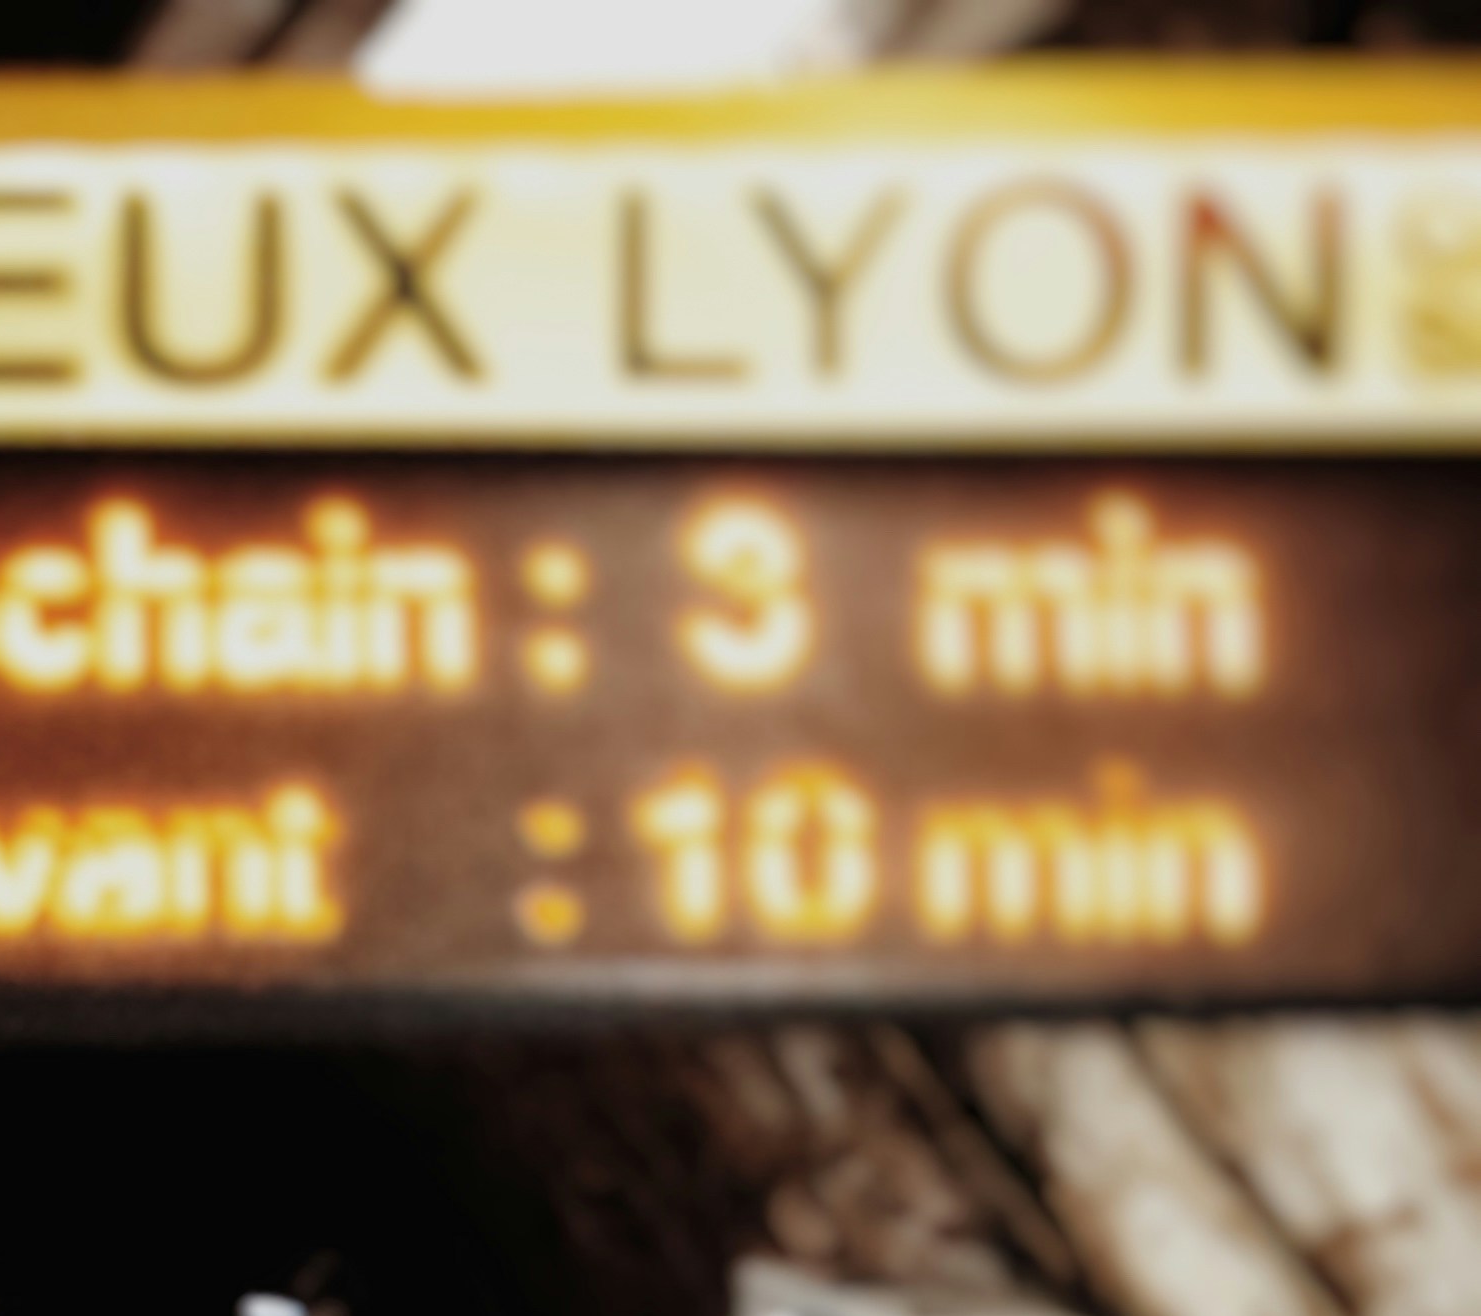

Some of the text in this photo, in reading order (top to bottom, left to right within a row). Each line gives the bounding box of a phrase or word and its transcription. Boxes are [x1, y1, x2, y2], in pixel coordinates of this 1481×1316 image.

[612, 184, 1349, 392] LYON
[682, 500, 812, 692] 3
[919, 492, 1263, 694] min
[635, 765, 873, 940] 10
[919, 758, 1263, 940] min
